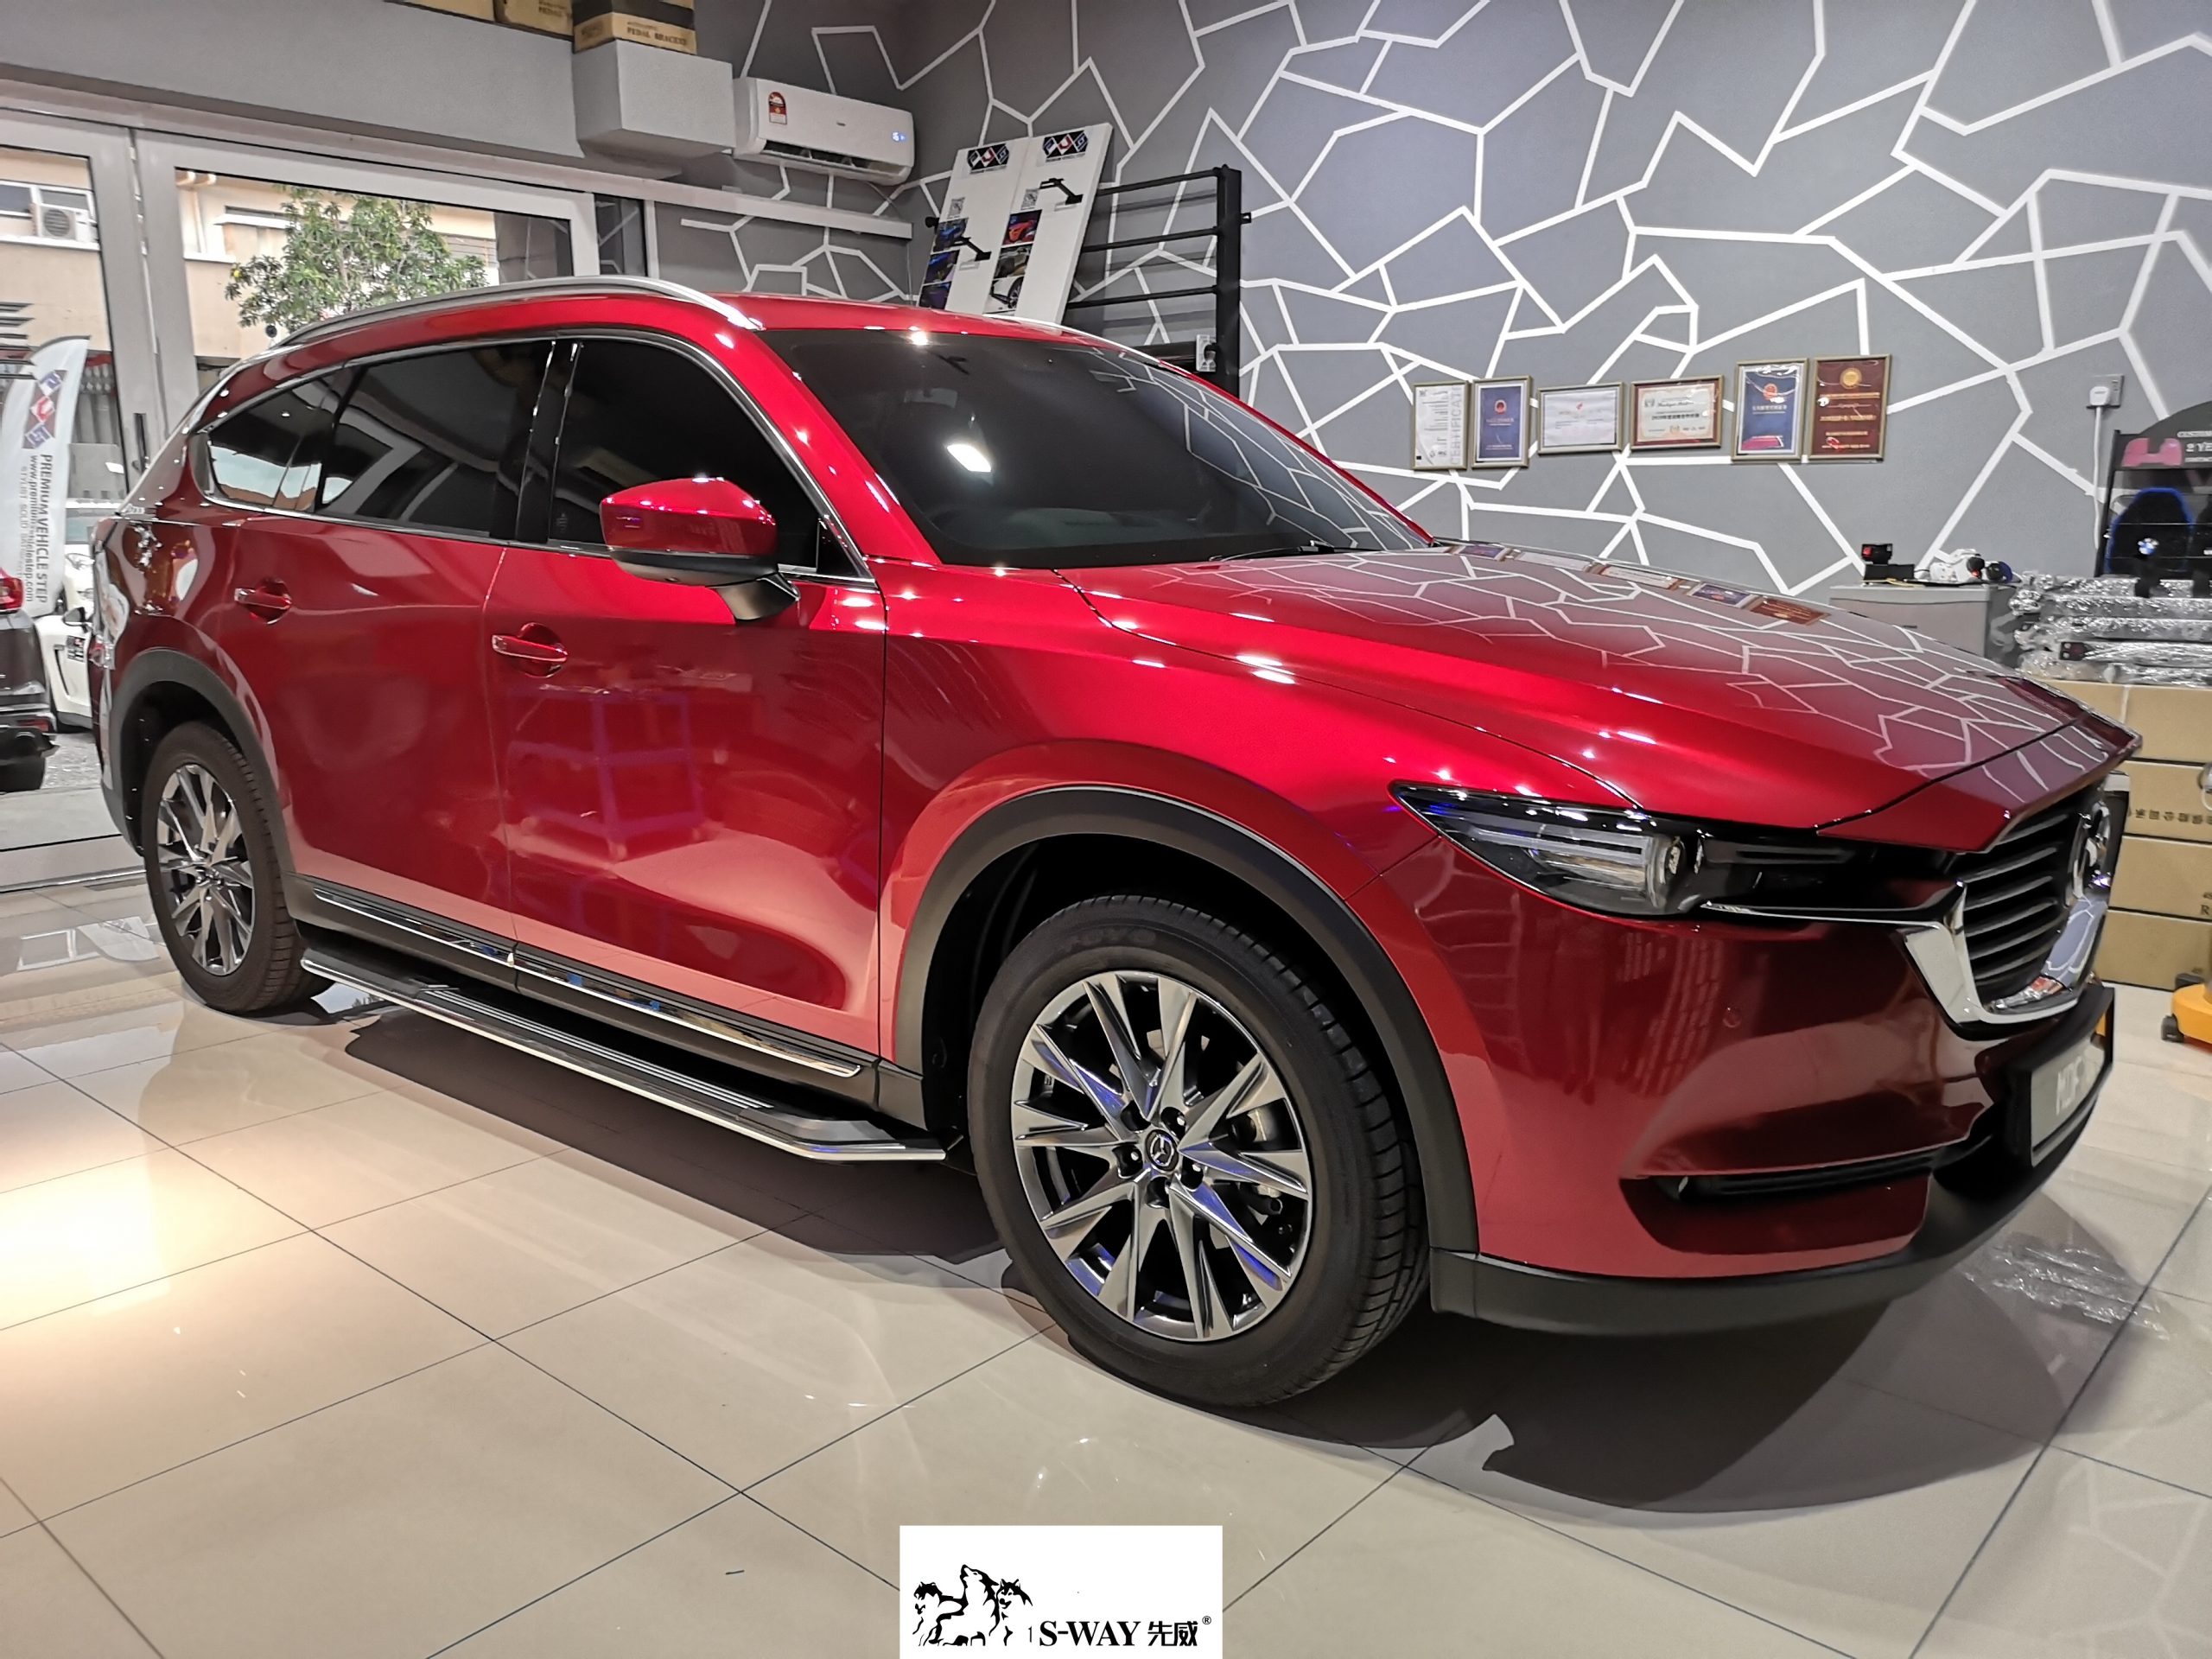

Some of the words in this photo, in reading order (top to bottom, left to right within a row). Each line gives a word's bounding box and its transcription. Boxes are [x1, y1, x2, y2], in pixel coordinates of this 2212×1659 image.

[39, 454, 53, 515] PREMIUM
[35, 518, 50, 569] VEHICLE
[35, 573, 49, 603] STEP
